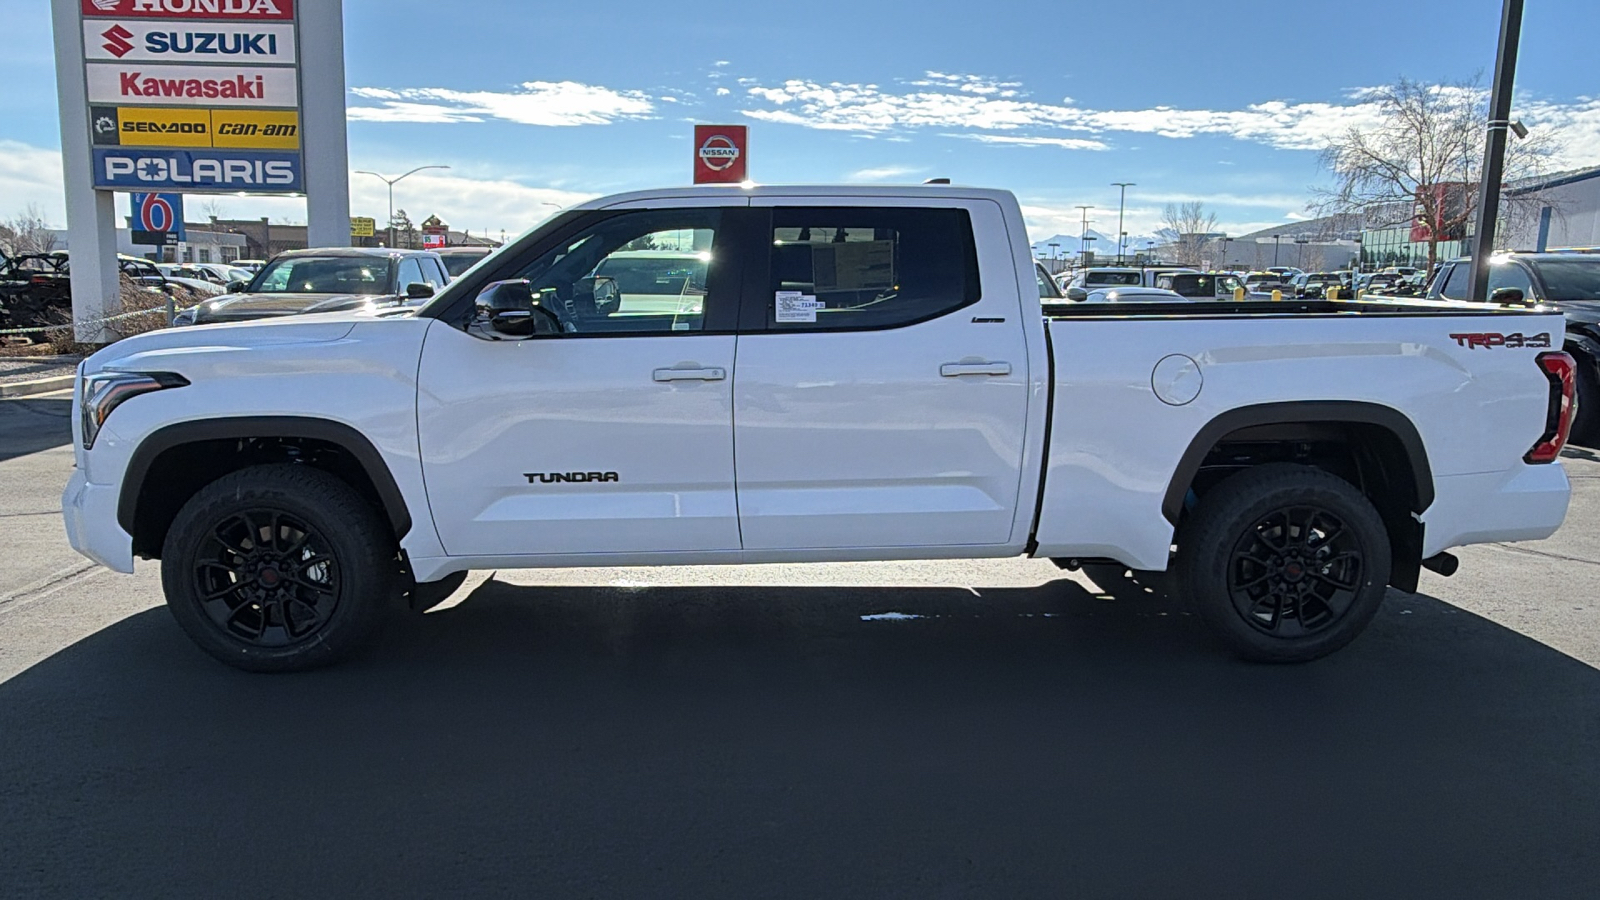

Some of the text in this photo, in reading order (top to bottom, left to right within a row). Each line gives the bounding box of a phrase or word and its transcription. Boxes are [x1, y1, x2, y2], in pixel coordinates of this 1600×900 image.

[132, 0, 281, 14] HONDA
[145, 31, 277, 55] SUZUKI
[119, 72, 264, 99] Kawasaki
[104, 156, 294, 184] POLARIS
[141, 192, 174, 232] 6
[1449, 332, 1505, 350] TRD
[523, 471, 619, 484] TUNDRA
